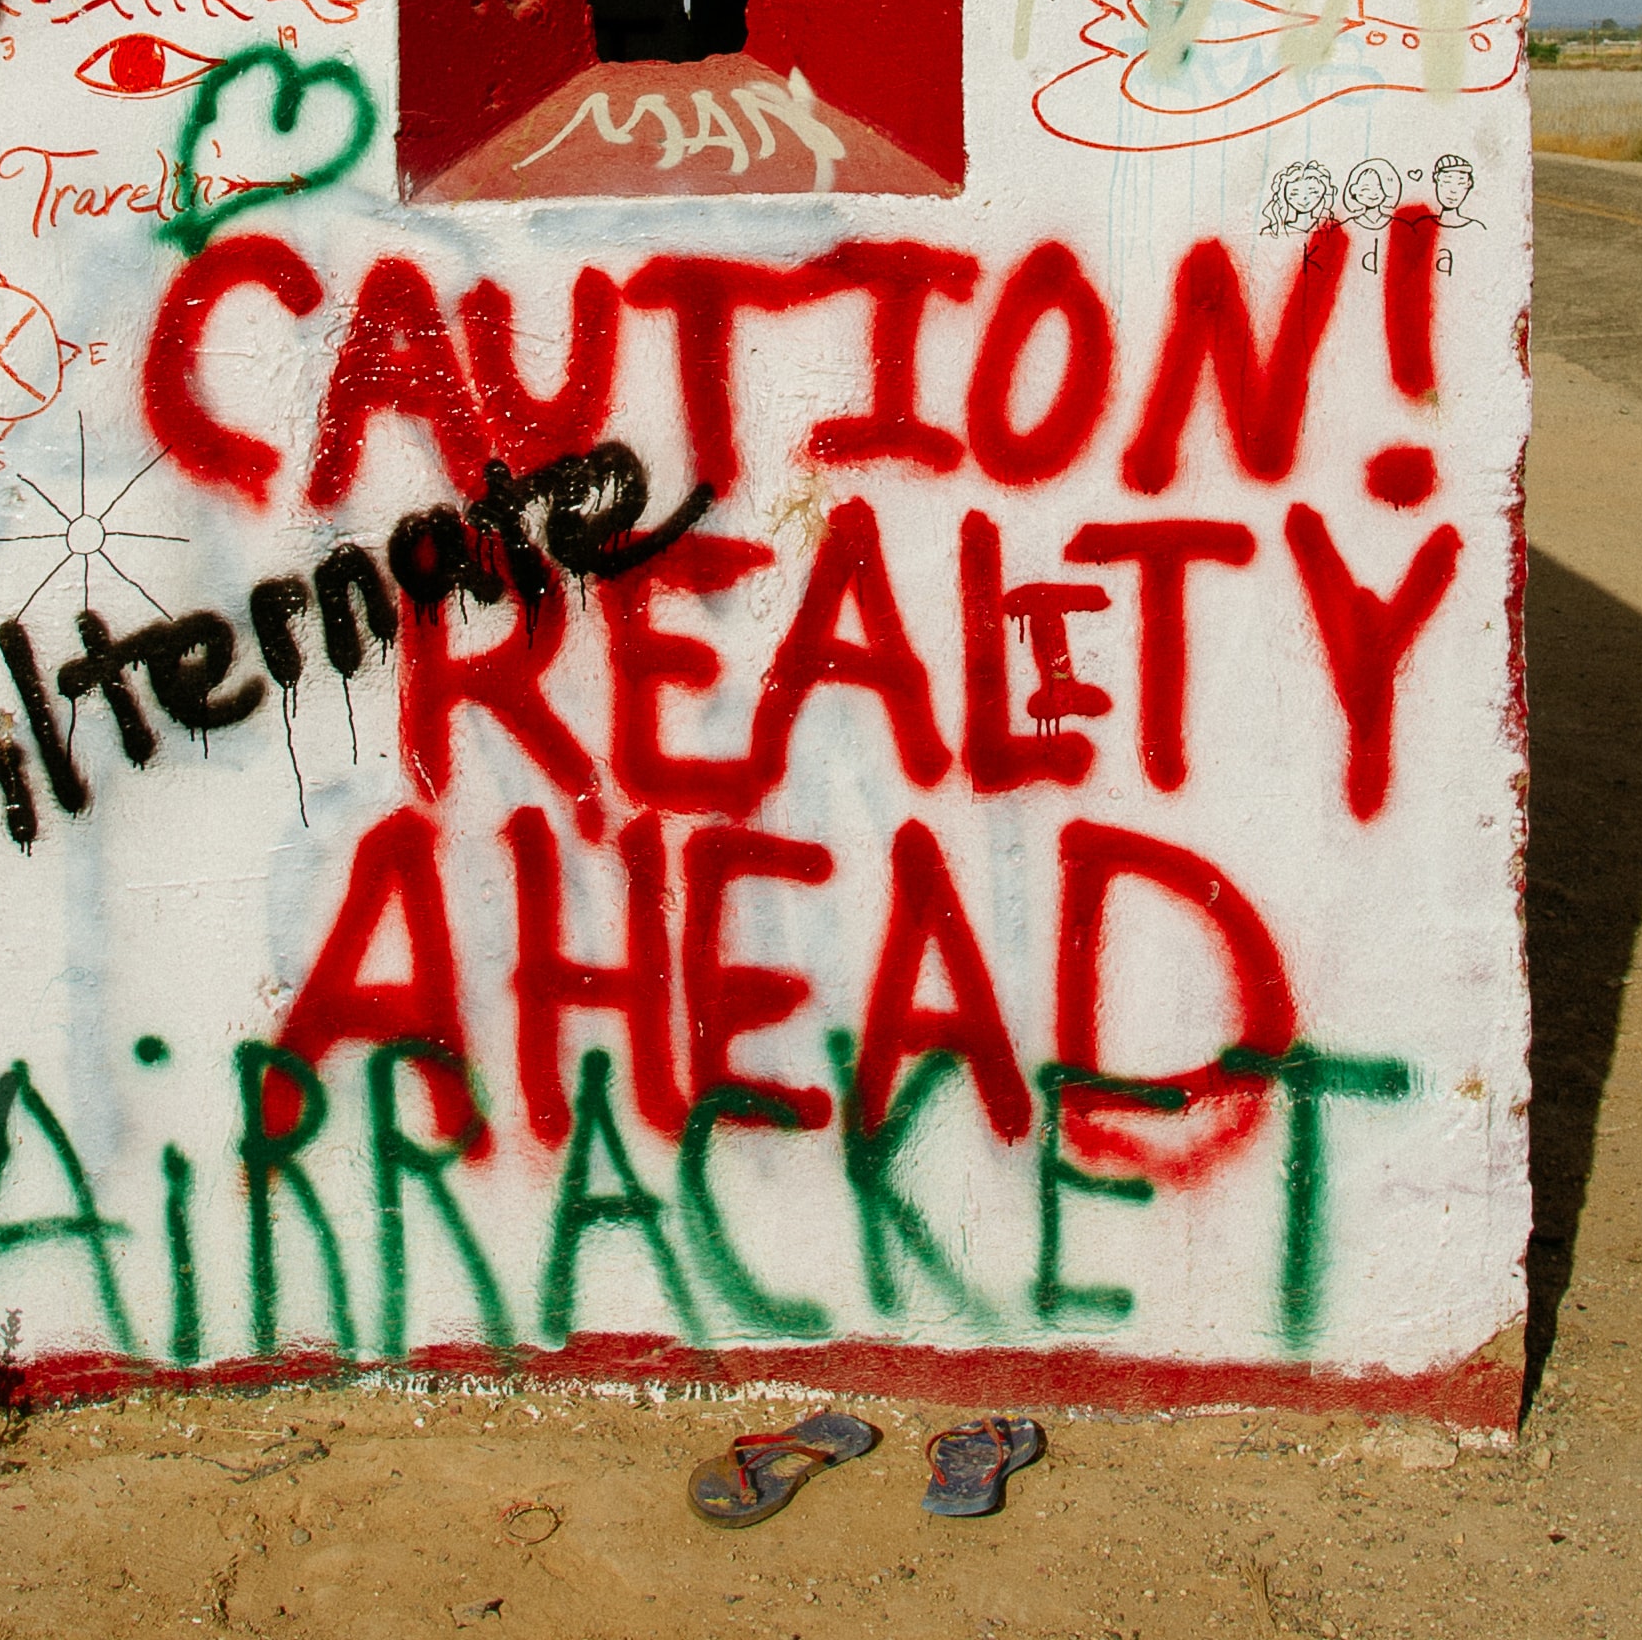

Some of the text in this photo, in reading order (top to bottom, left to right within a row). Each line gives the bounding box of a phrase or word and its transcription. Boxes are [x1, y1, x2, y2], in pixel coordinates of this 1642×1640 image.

[0, 36, 16, 60] 3
[277, 25, 298, 50] 19
[87, 342, 109, 366] E
[143, 202, 1440, 510] CAUTION!
[399, 497, 1464, 844] REALITY
[269, 803, 1299, 1185] AHEAD
